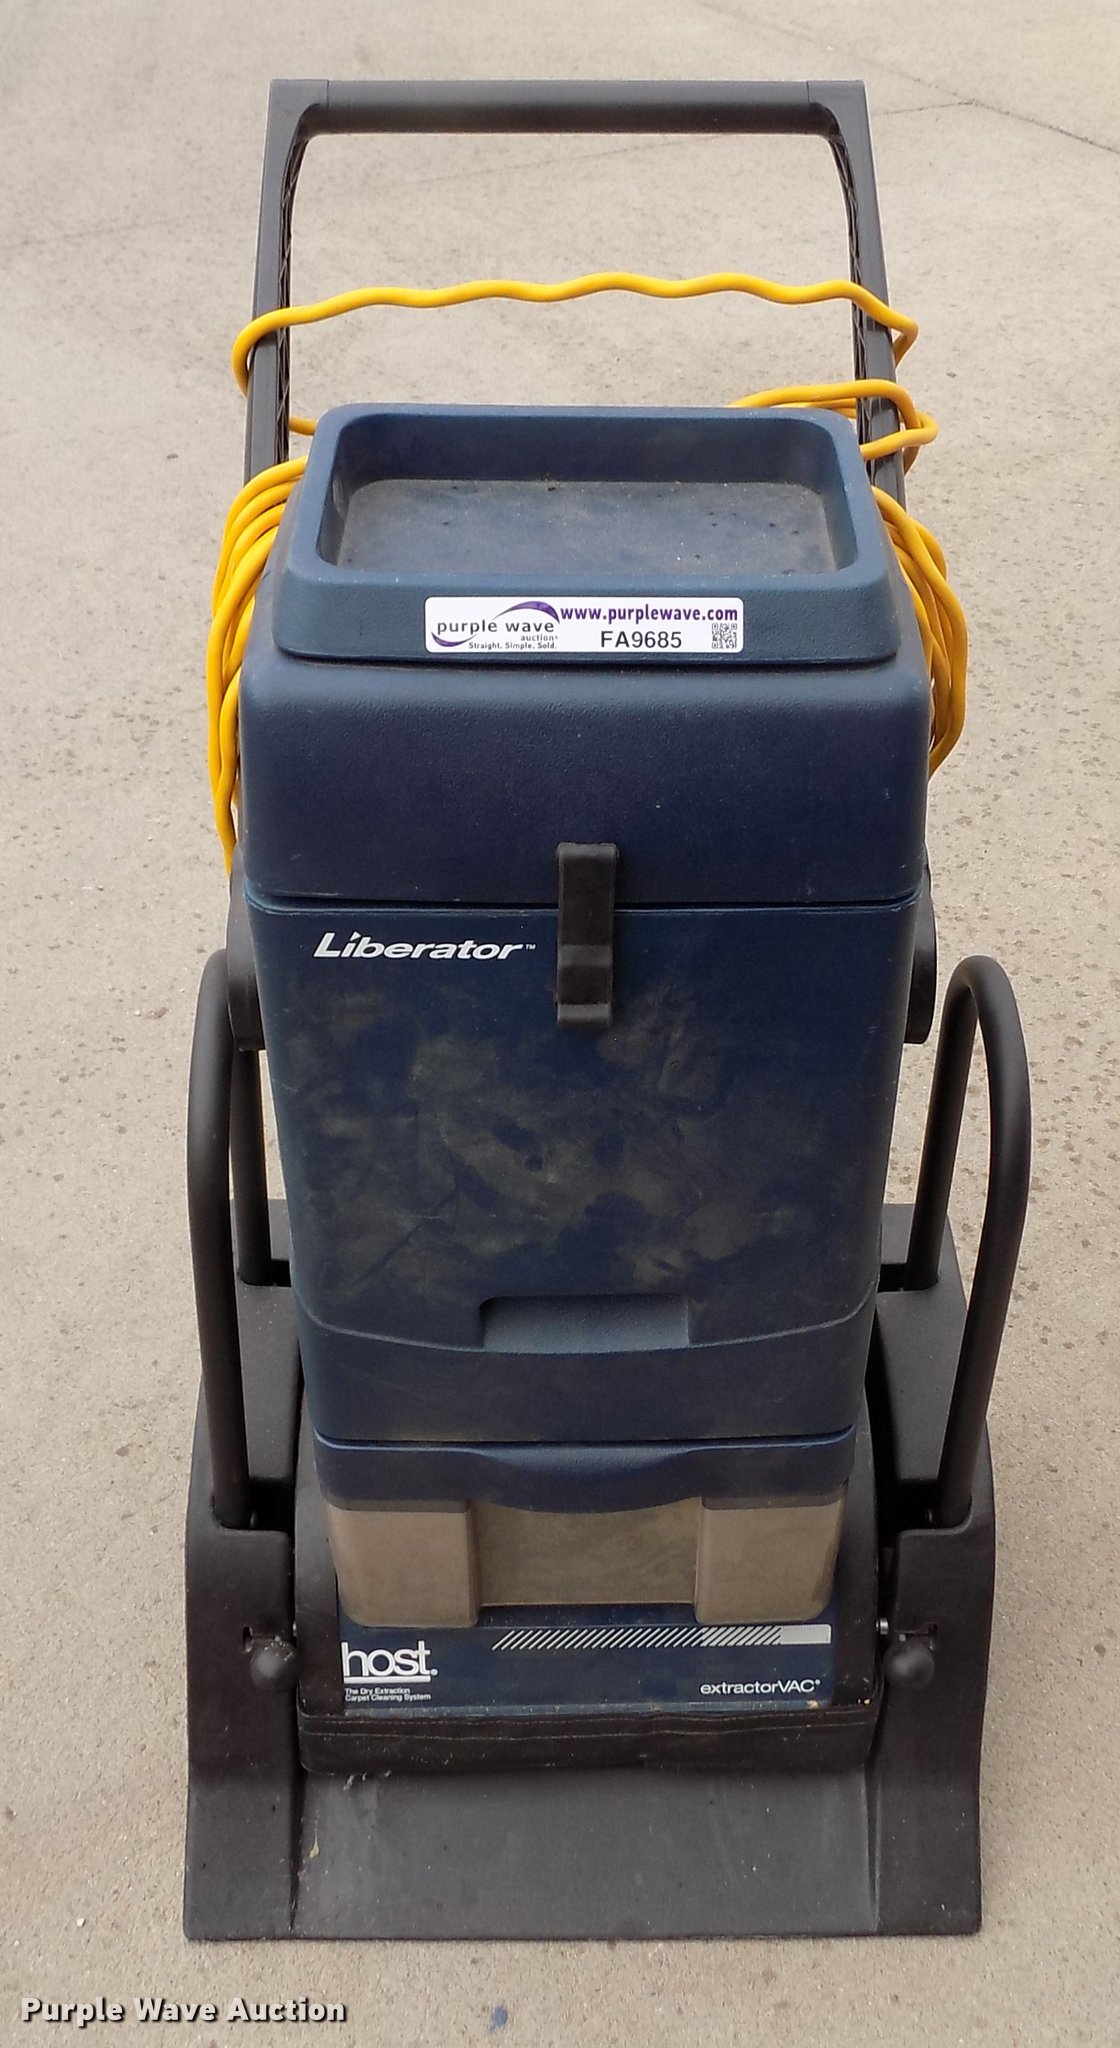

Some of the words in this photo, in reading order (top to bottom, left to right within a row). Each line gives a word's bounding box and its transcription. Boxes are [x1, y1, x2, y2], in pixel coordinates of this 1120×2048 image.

[560, 603, 738, 624] www.purplewave.com
[437, 619, 497, 634] purple
[505, 622, 554, 632] wave
[520, 634, 554, 642] auction
[601, 630, 682, 648] FA9685
[313, 932, 523, 960] Liberator
[345, 1694, 370, 1703] Carpet
[371, 1693, 403, 1702] Cleaning
[360, 1688, 373, 1697] Dry
[374, 1687, 411, 1695] Extraction
